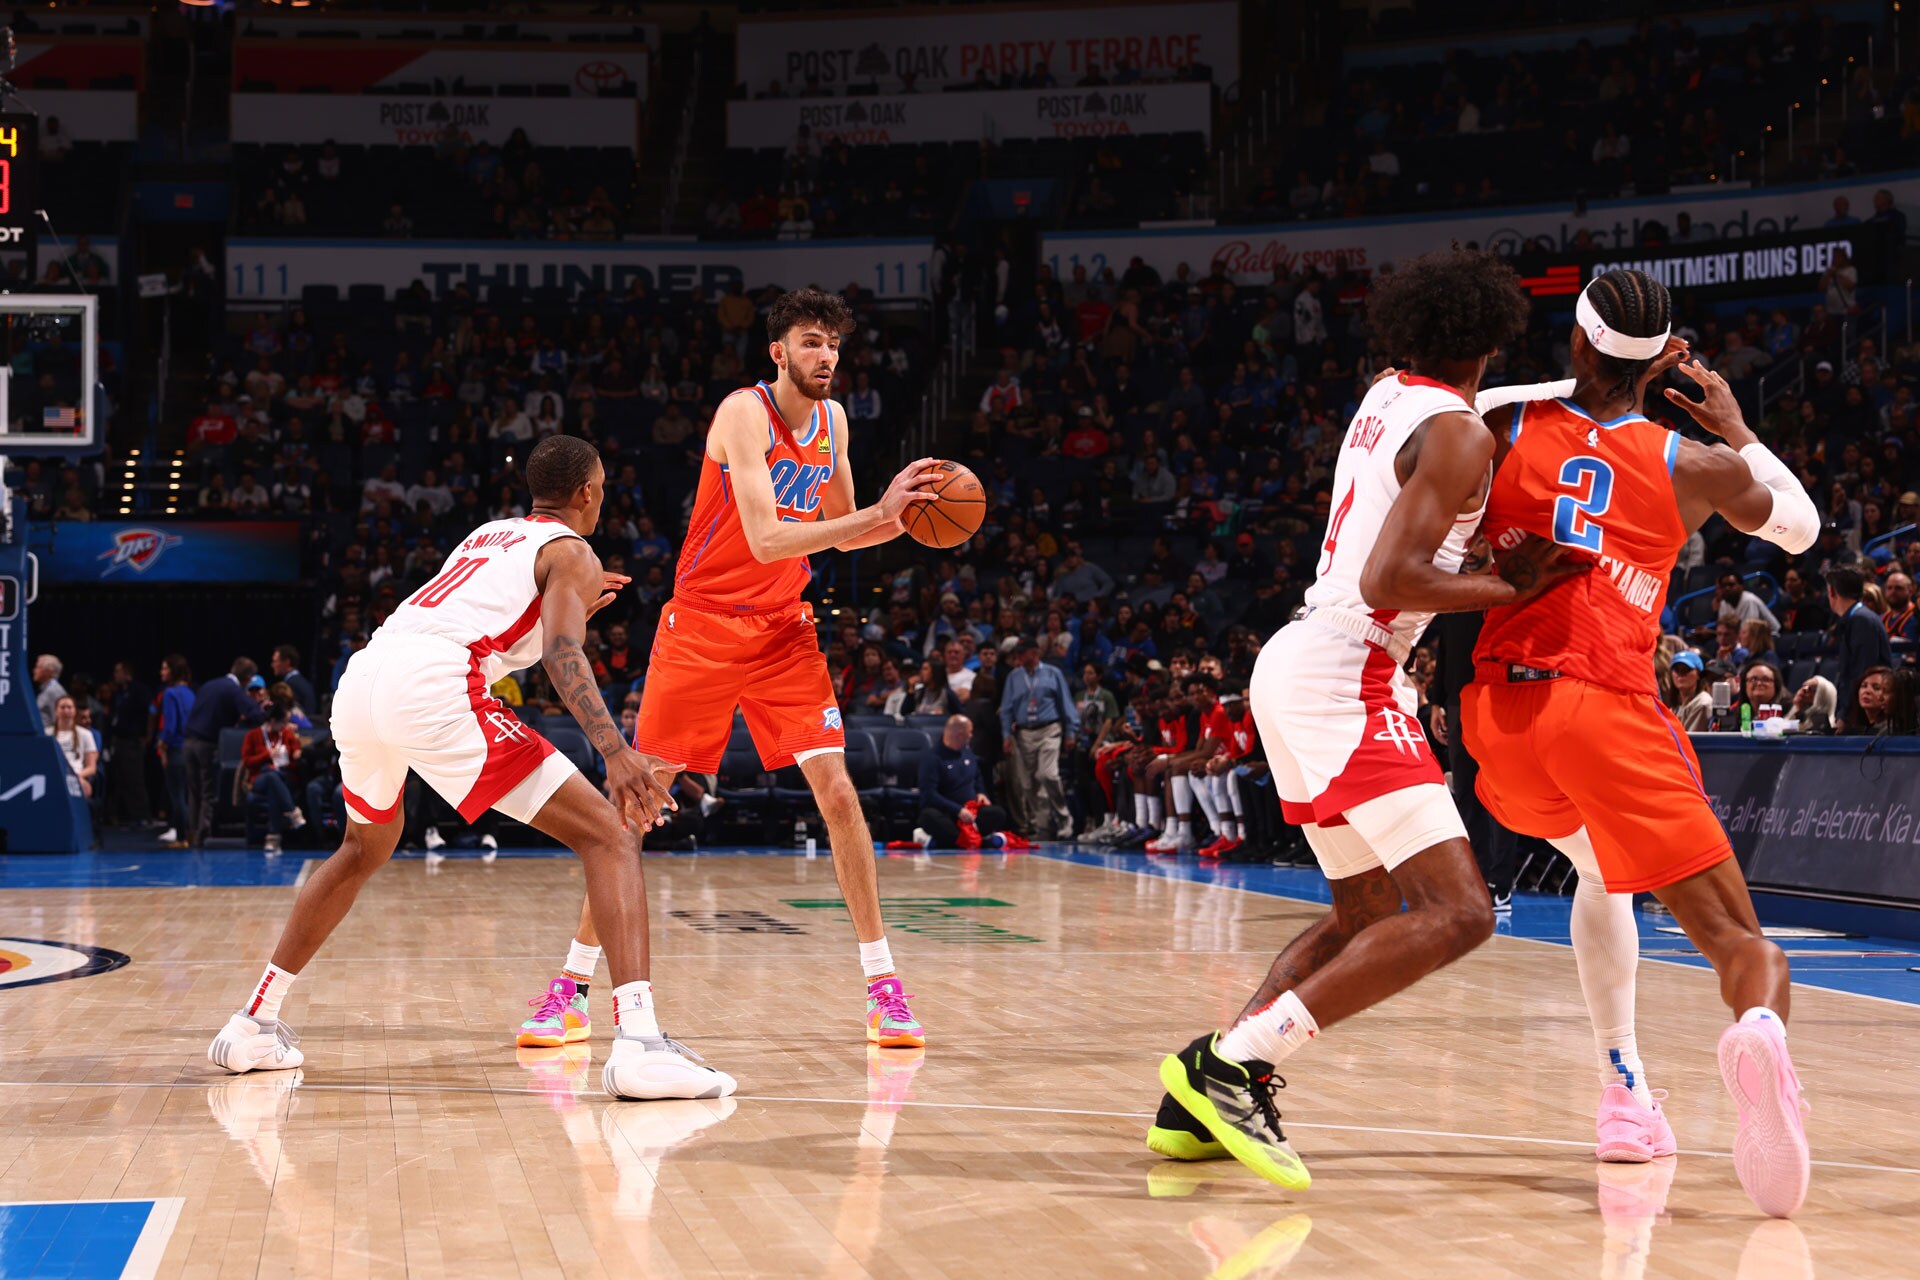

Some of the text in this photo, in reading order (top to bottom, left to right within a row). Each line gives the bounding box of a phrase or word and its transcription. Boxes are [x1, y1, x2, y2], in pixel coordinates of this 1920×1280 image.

[787, 35, 1202, 83] POST OAK PARTY TERRACE
[380, 103, 489, 126] POST OAK
[800, 103, 906, 128] POST OAK
[1038, 93, 1147, 119] POST OAK
[395, 128, 474, 145] TOYOA
[1052, 120, 1131, 137] TOYOTA
[1212, 240, 1367, 275] Bally SPORTS
[1743, 245, 1798, 281] RUNS
[233, 263, 288, 295] 111
[422, 263, 744, 303] THUNDER
[875, 261, 928, 294] 111
[1350, 416, 1386, 456] GREEN
[770, 459, 832, 513] OKC
[1552, 455, 1615, 554] 2
[462, 531, 513, 552] SMITH
[408, 557, 489, 608] 10
[1730, 795, 1790, 840] all-new,
[1790, 800, 1880, 841] all-electric
[1879, 803, 1912, 844] Kia
